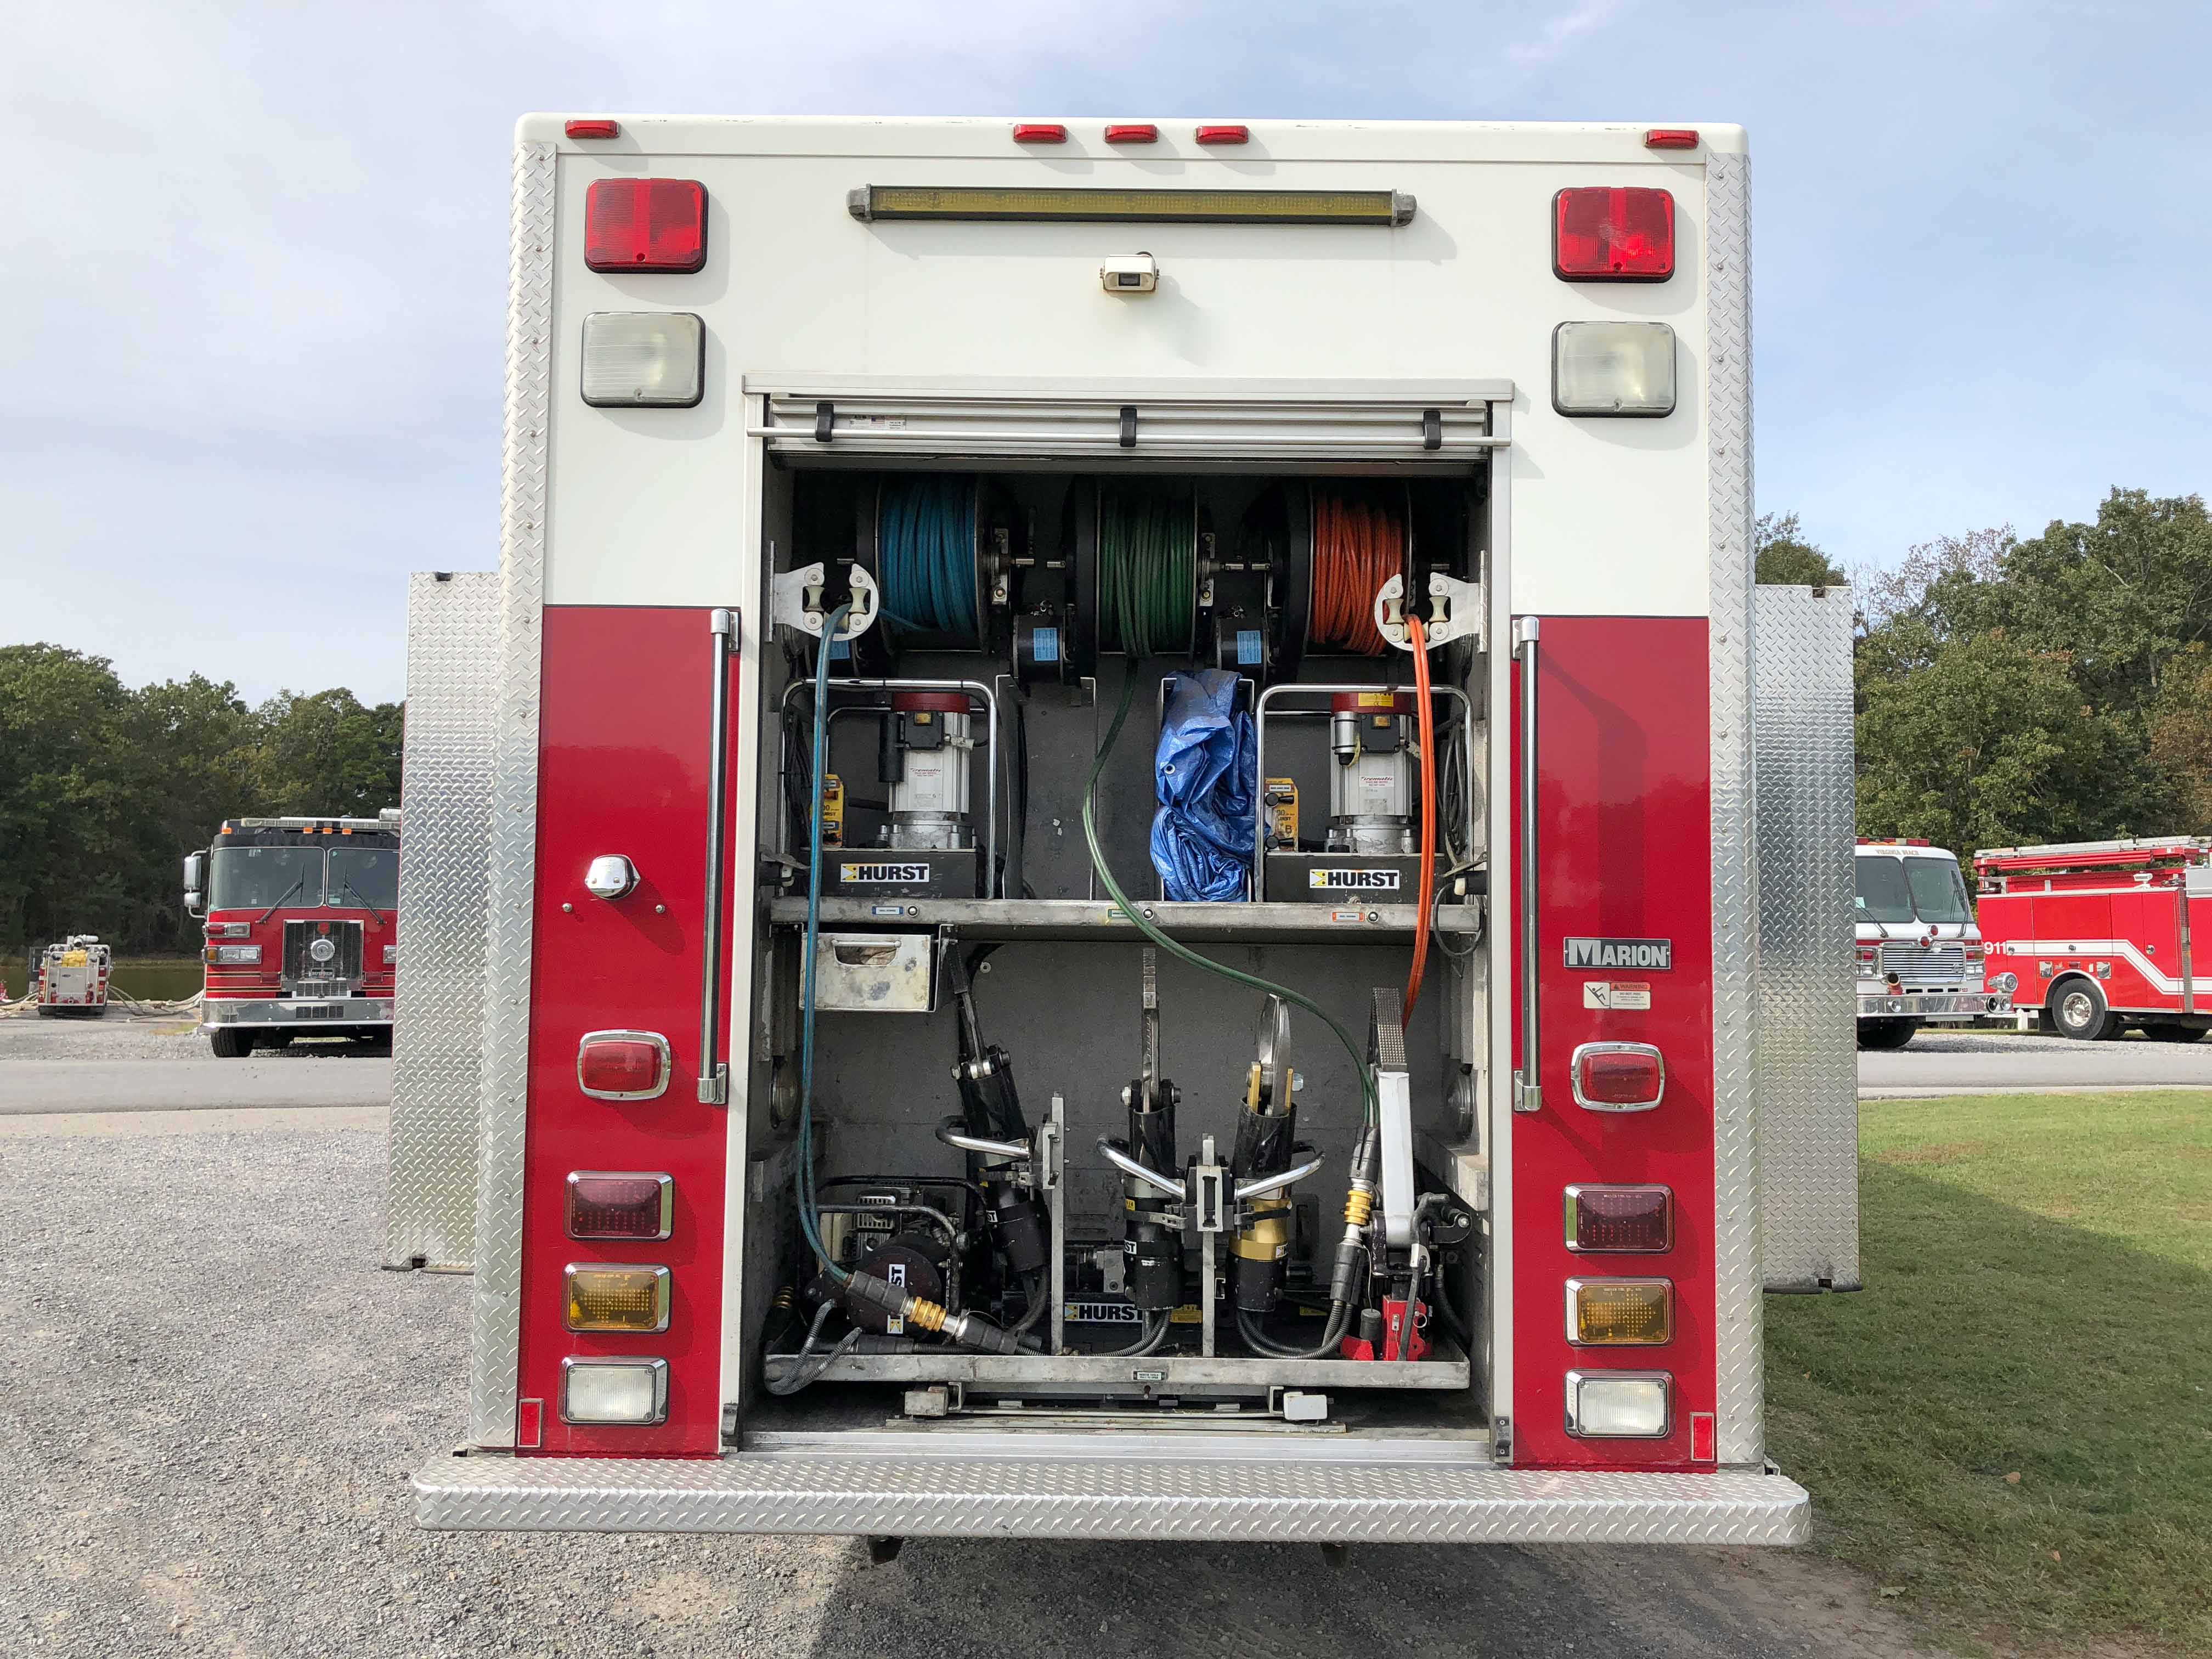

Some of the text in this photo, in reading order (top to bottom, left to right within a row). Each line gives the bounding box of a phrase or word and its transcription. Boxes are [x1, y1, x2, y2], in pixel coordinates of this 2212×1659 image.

[859, 866, 928, 881] HURST
[1328, 872, 1398, 887] HURST
[1568, 939, 1668, 967] MARION
[1984, 941, 2006, 955] 911
